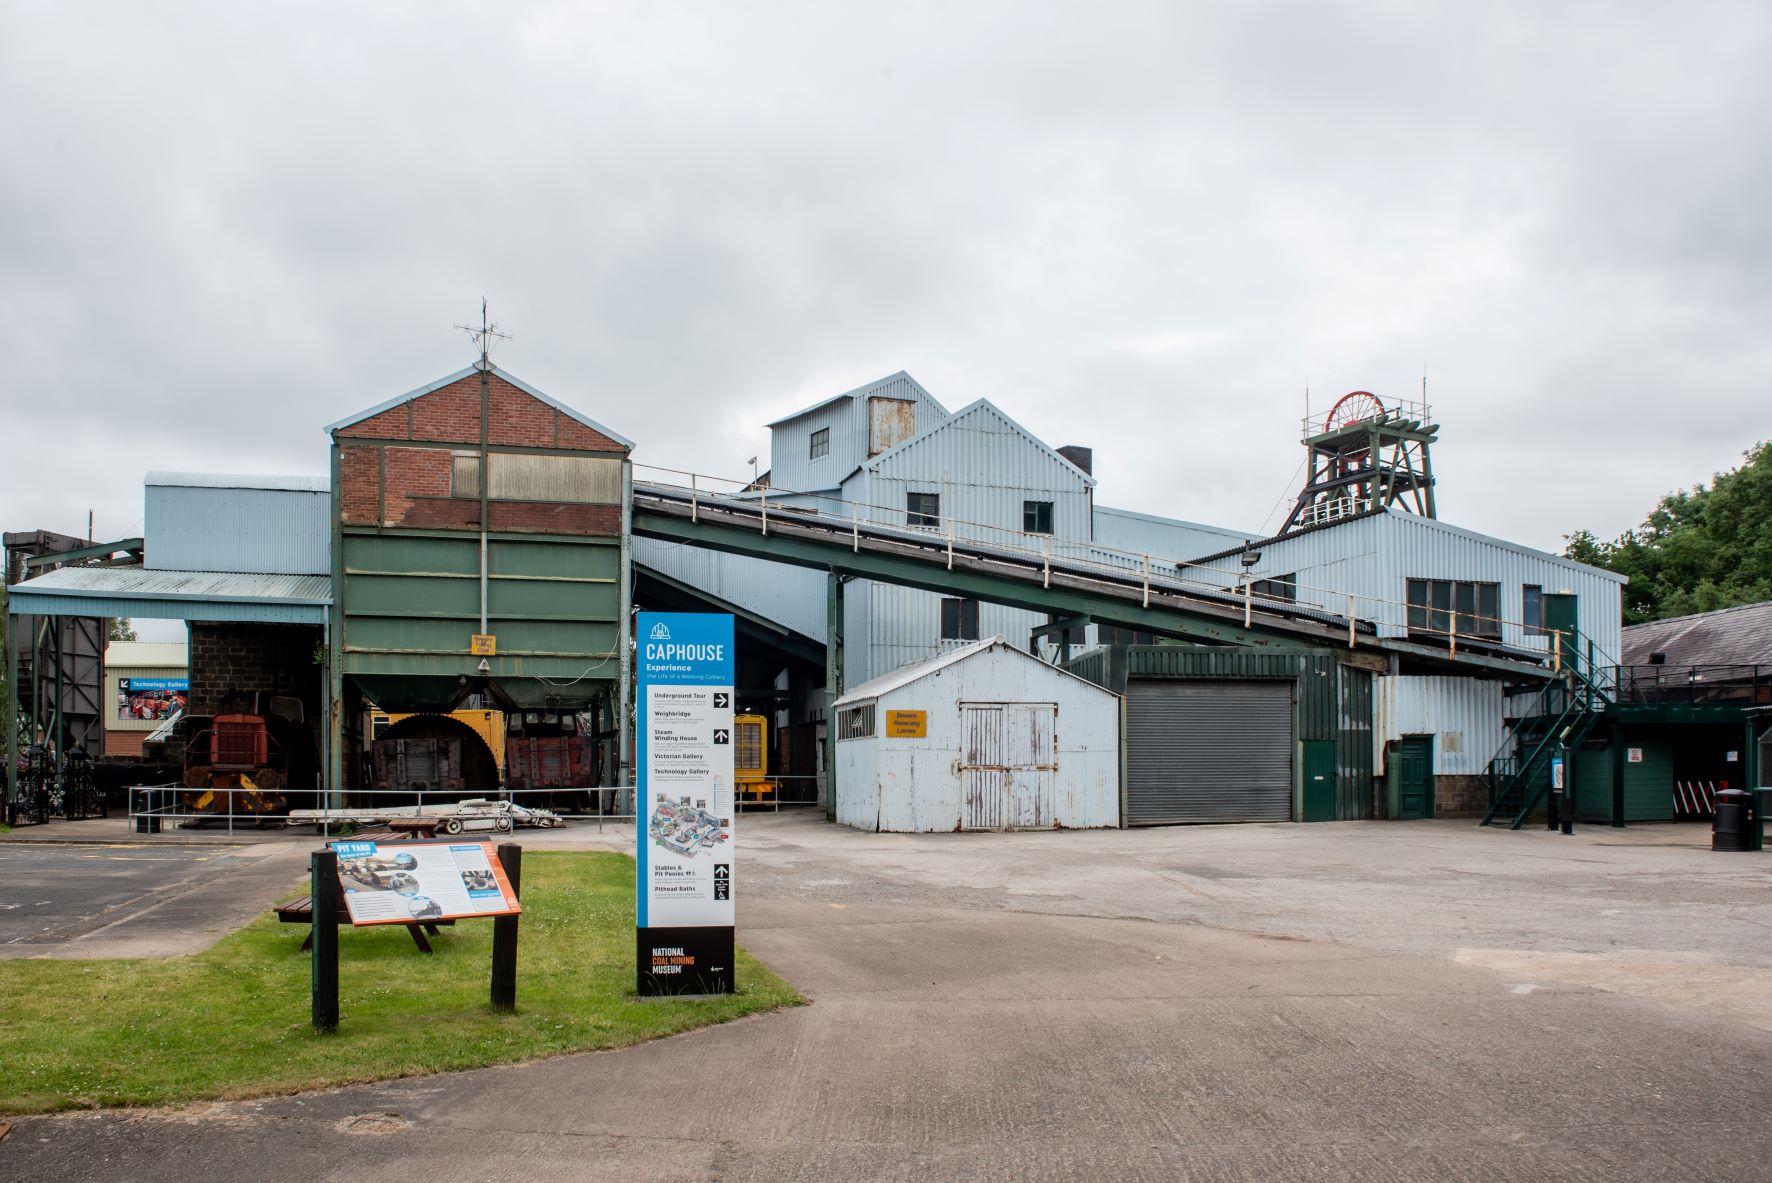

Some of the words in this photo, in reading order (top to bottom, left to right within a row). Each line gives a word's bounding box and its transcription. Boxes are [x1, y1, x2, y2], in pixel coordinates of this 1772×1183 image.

[646, 644, 724, 661] CAPHOUSE
[646, 664, 692, 672] Experience
[337, 844, 350, 852] PIT
[351, 844, 371, 852] YARD
[652, 948, 684, 956] NATIONAL
[652, 957, 669, 965] COAL
[670, 956, 695, 965] MINING
[652, 965, 682, 974] MUSEUM
